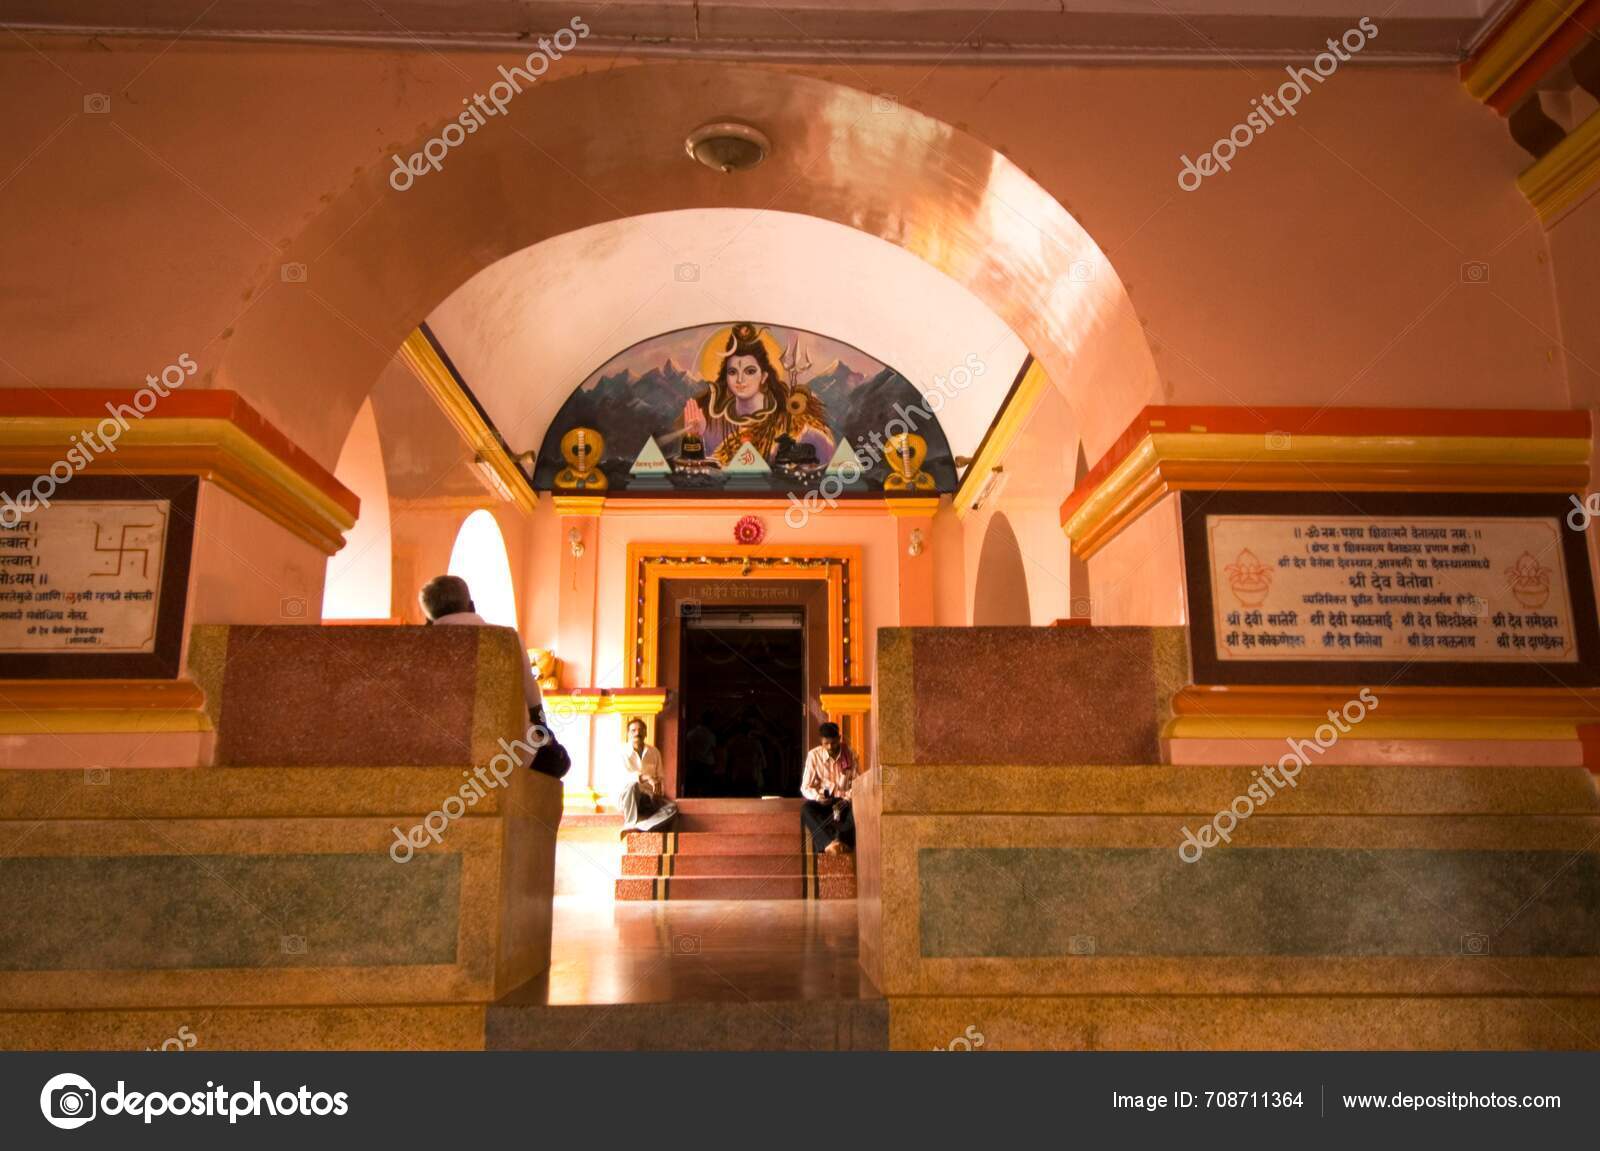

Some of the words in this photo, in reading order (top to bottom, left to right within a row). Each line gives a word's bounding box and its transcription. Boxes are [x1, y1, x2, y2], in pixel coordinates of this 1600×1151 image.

[1348, 571, 1365, 588] श्री
[1371, 572, 1391, 590] देव
[1396, 571, 1433, 588] वेतोबा
[1227, 610, 1241, 626] श्री
[1310, 610, 1325, 627] श्री
[1401, 611, 1414, 627] श्री
[1418, 611, 1432, 628] देव
[1492, 611, 1506, 628] श्री
[1508, 612, 1522, 629] देव
